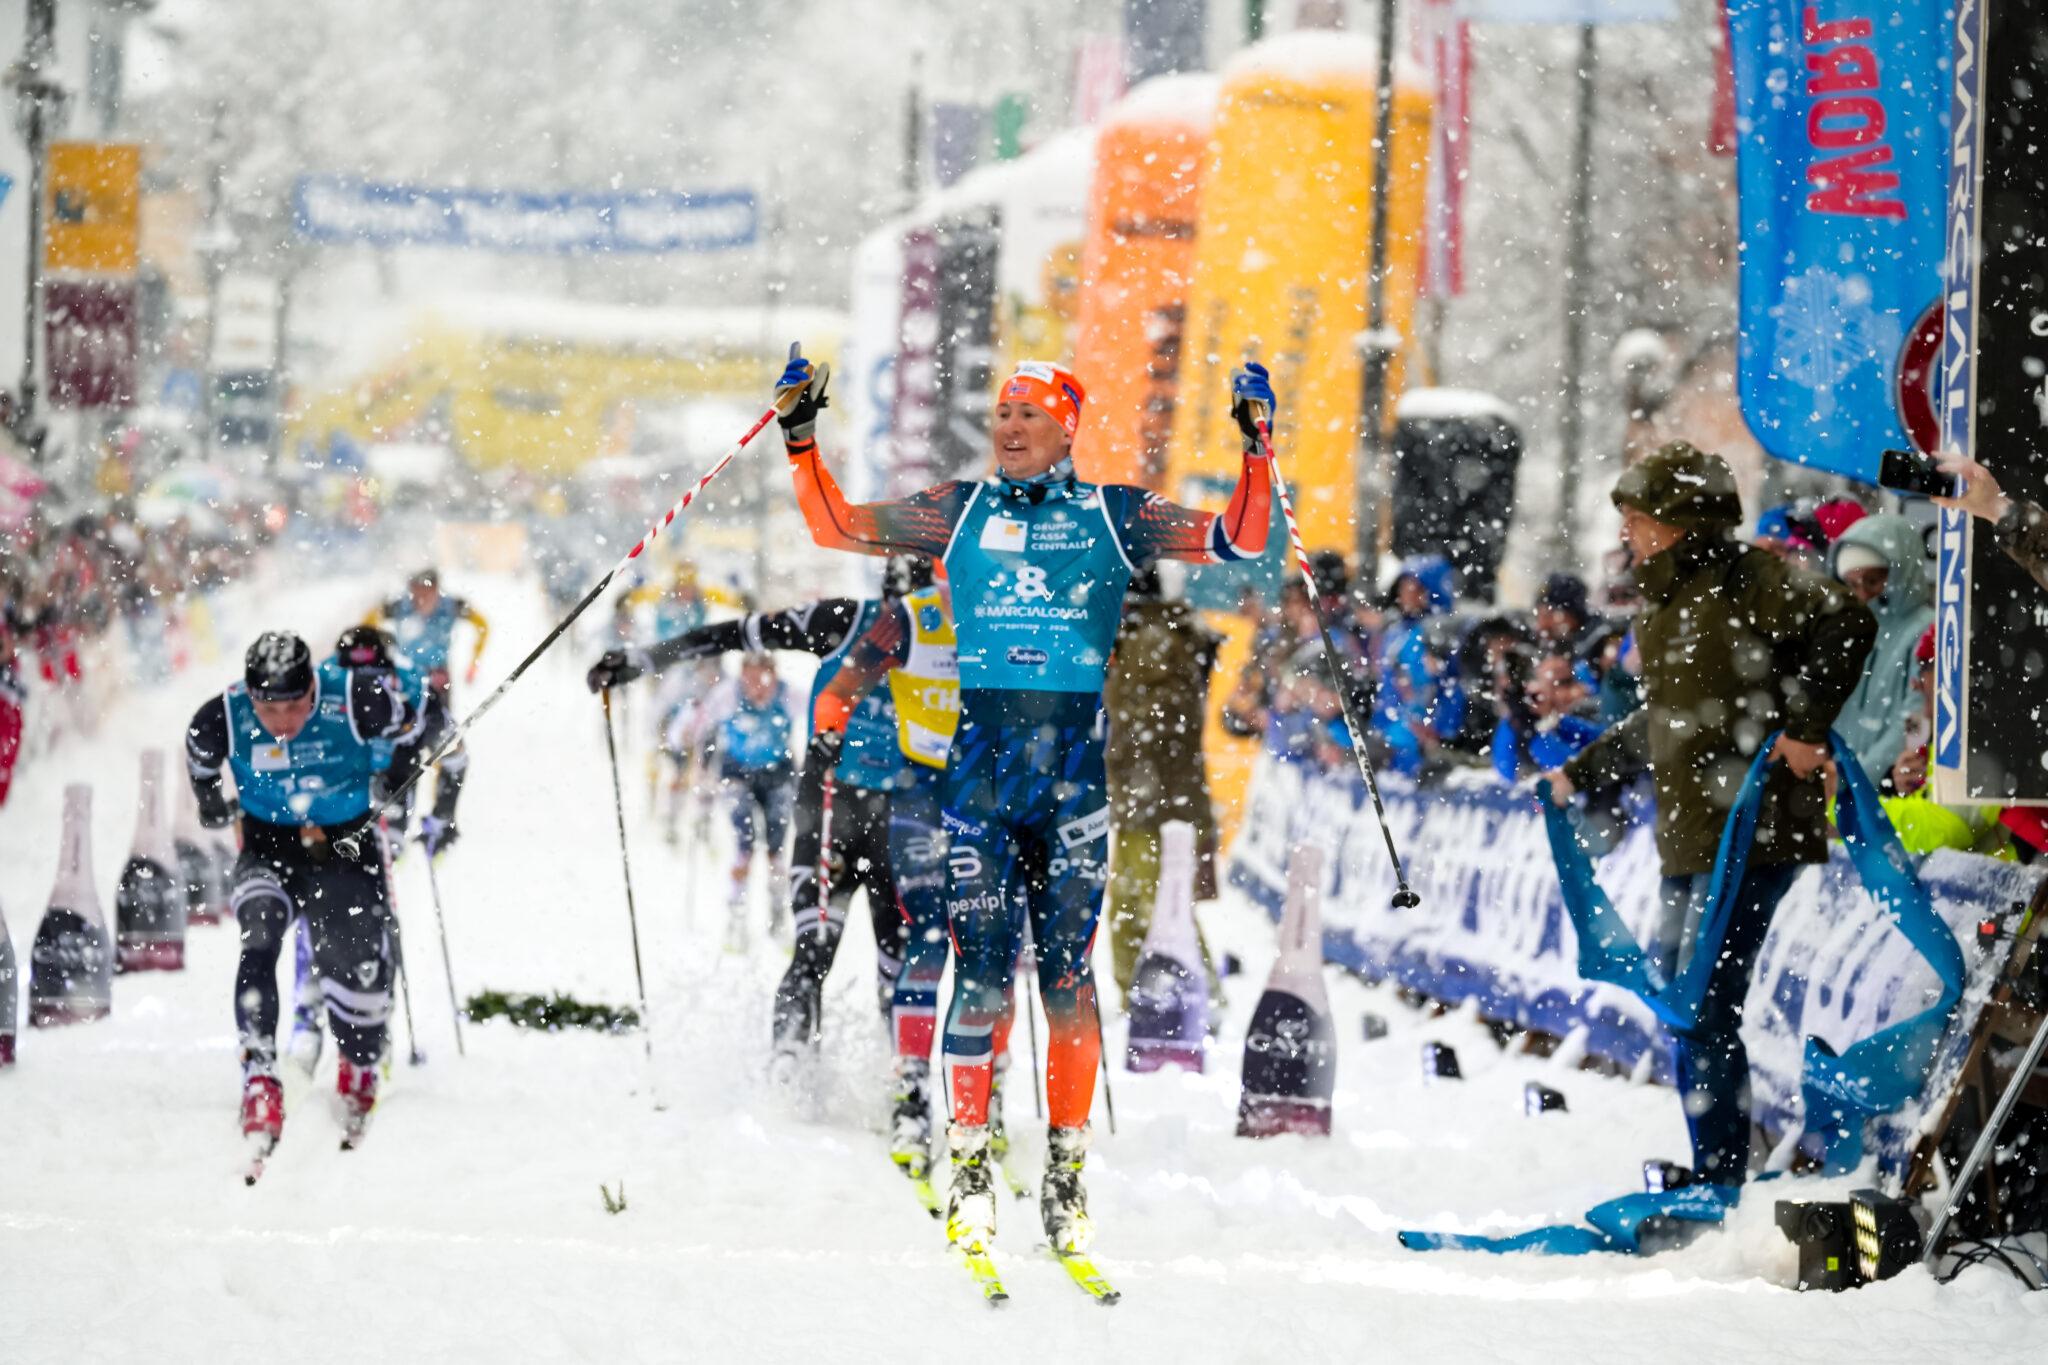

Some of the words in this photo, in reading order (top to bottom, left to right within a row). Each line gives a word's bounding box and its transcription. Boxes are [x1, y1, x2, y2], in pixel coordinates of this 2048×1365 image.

[1033, 521, 1079, 531] GRUPPO
[1031, 532, 1068, 541] CASSA
[1031, 541, 1088, 551] CENTRALE
[1014, 566, 1048, 598] 8
[986, 604, 1088, 620] MARCIALONGA
